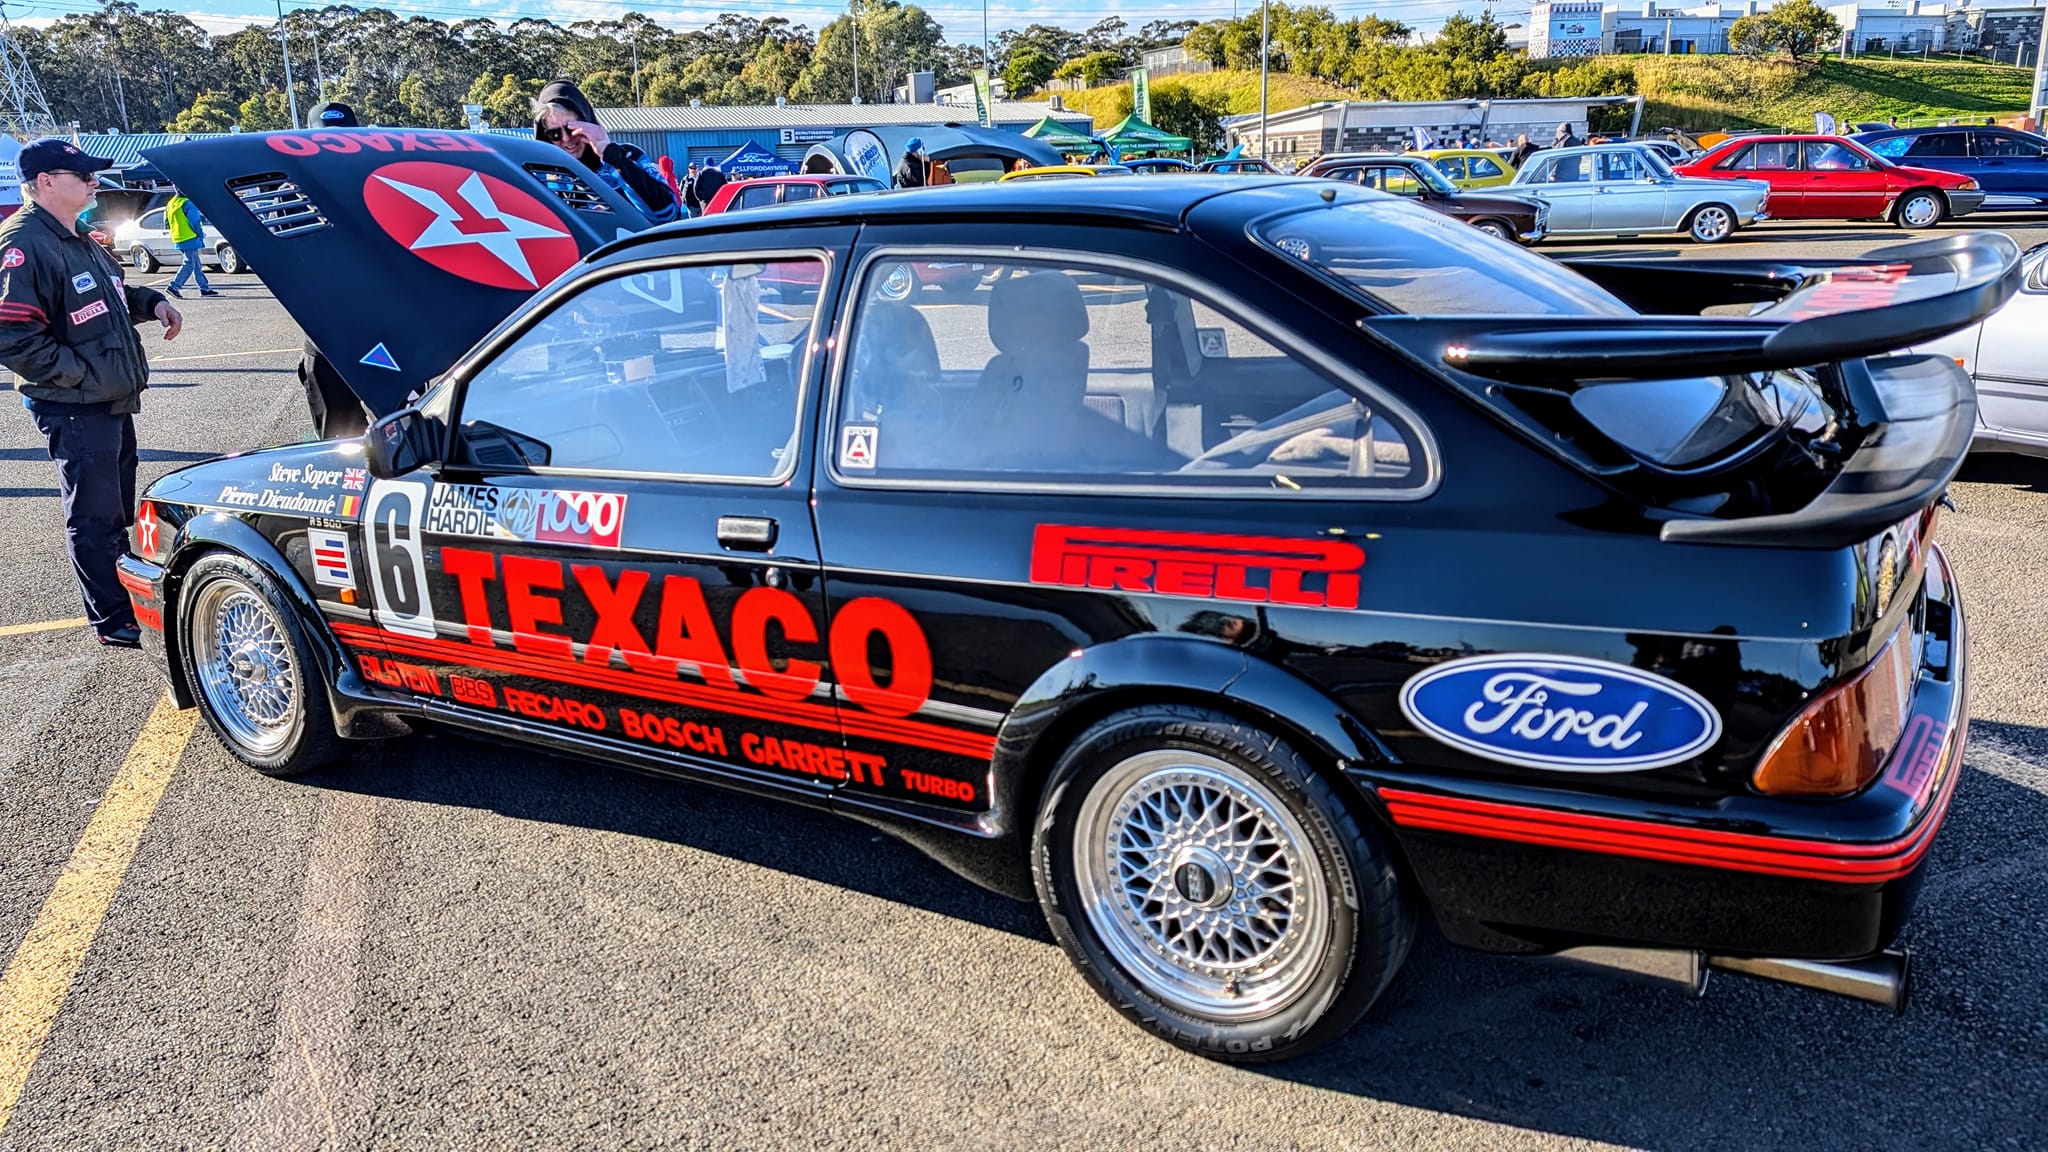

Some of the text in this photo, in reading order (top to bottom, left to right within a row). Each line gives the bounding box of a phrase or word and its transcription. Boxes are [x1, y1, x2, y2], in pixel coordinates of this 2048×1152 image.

[265, 133, 497, 156] TEXACO
[737, 152, 774, 163] Ford
[847, 434, 870, 458] A
[268, 463, 342, 490] Steve Soper
[216, 486, 336, 514] Pierre Dieudonné
[432, 484, 499, 512] JAMES
[309, 516, 342, 528] RS 500
[428, 507, 495, 536] HARDIE
[537, 491, 619, 536] 1000
[374, 492, 420, 619] 6
[1030, 522, 1366, 610] PIRELLI
[440, 546, 933, 717] TEXACO
[1464, 672, 1649, 749] Ford
[358, 654, 975, 802] BILSTEIN BBS RECARO BOSCH GARRETT TURBO
[1884, 713, 1949, 801] PIRELLI
